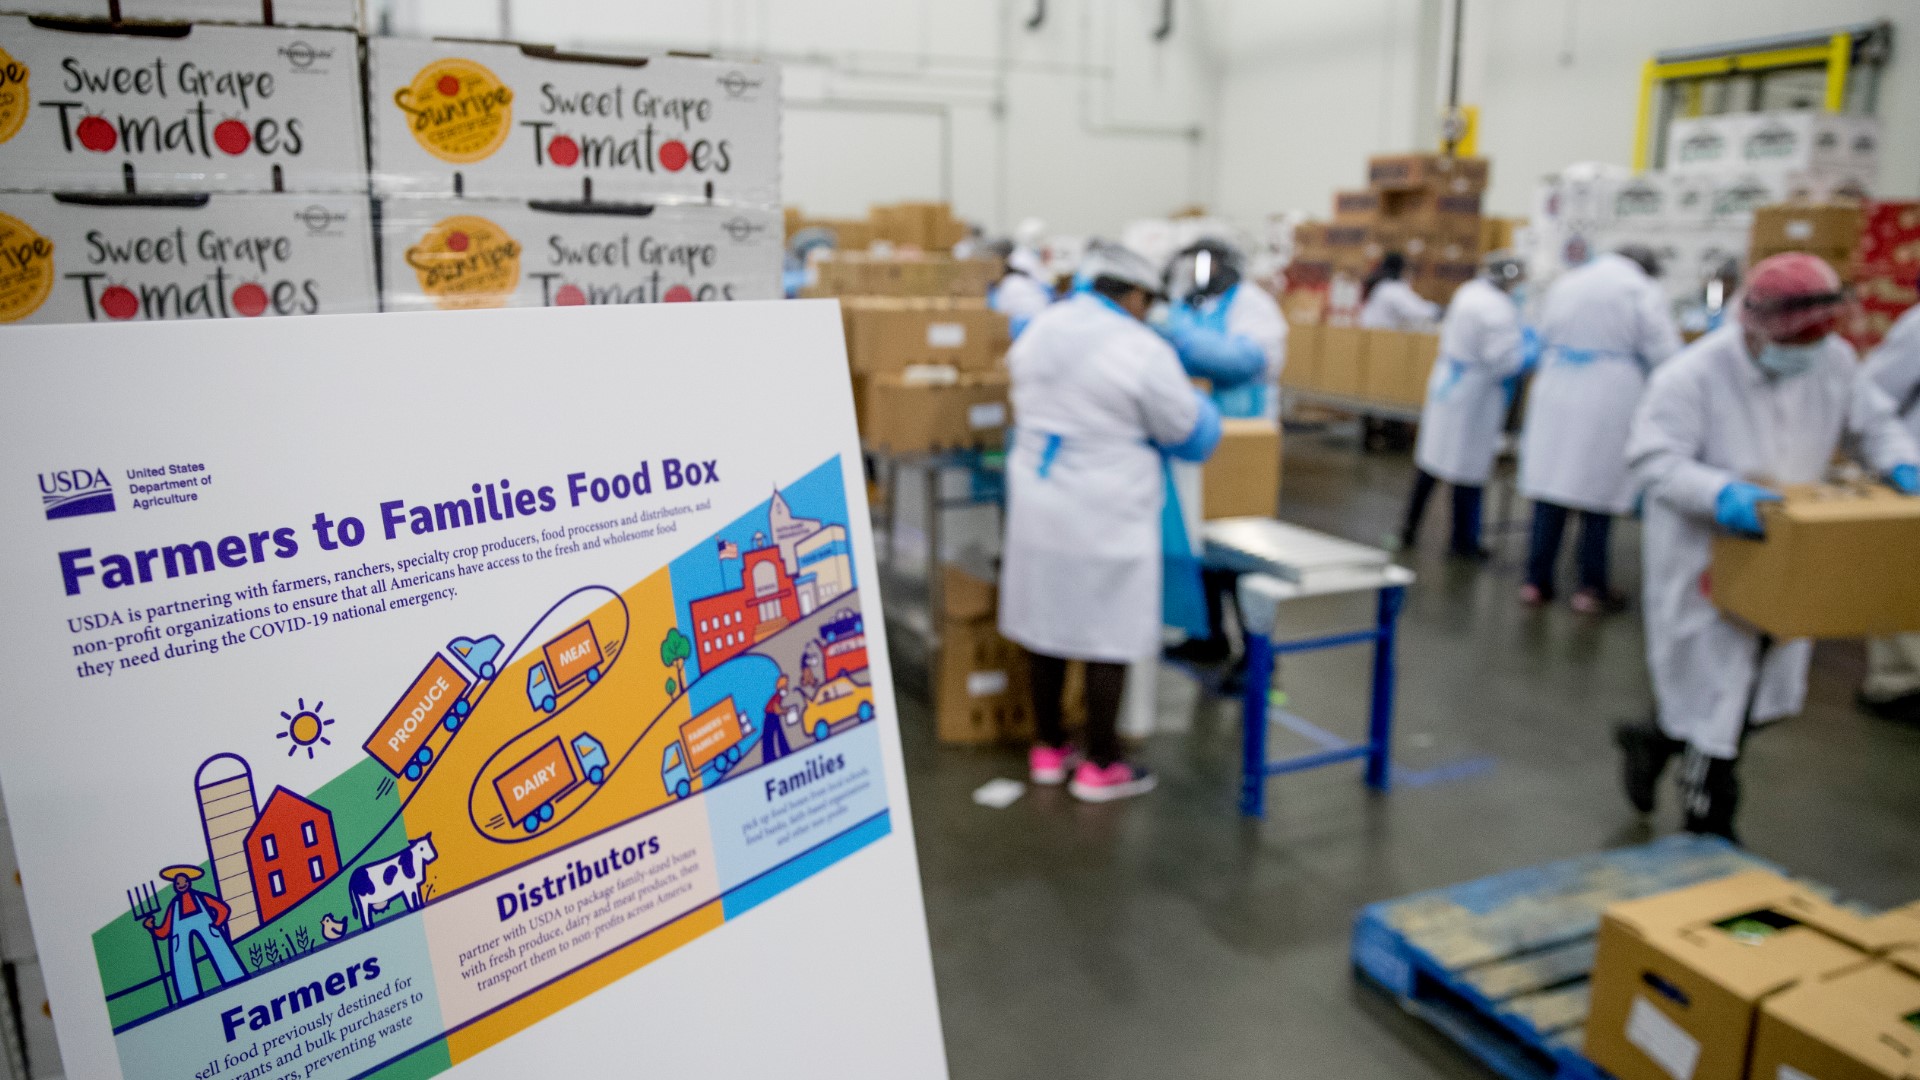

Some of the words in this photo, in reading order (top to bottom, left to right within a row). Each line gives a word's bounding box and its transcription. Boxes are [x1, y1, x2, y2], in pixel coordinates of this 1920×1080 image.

[61, 57, 167, 98] Sweet
[178, 62, 275, 110] Grape
[540, 82, 624, 119] Sweet
[634, 88, 711, 130] Grape
[39, 100, 303, 159] Tomatoes
[519, 121, 731, 175] Tomatoes
[85, 227, 188, 266] Sweet
[198, 231, 291, 273] Grape
[548, 235, 629, 268] Sweet
[639, 238, 716, 276] Grape
[64, 267, 320, 320] Tomatoes
[38, 467, 112, 495] USDA
[126, 466, 165, 480] United
[168, 462, 205, 476] States
[129, 476, 197, 495] Department
[200, 474, 212, 486] of
[58, 525, 299, 596] Farmers
[312, 512, 365, 551] to
[380, 478, 557, 541] Families
[567, 460, 652, 507] Food
[661, 458, 719, 490] Box
[132, 491, 198, 510] Agriculture
[67, 611, 124, 633] USDA
[128, 608, 142, 622] is
[146, 593, 232, 623] partnering
[234, 583, 268, 601] with
[272, 574, 331, 594] farmers,
[334, 563, 394, 582] ranchers,
[397, 550, 450, 572] specialty
[453, 544, 478, 560] crop
[481, 537, 539, 557] producers,
[542, 526, 565, 542] food
[568, 517, 619, 539] processors
[621, 511, 638, 526] and
[640, 505, 693, 522] distributors,
[696, 498, 711, 511] and
[72, 625, 162, 656] non-profit
[166, 604, 271, 637] organizations
[274, 602, 288, 615] to
[292, 592, 338, 611] ensure
[341, 585, 368, 601] that
[370, 578, 387, 594] all
[390, 569, 456, 591] Americans
[457, 564, 484, 577] have
[487, 553, 520, 570] access
[523, 551, 533, 563] to
[536, 548, 552, 560] the
[555, 541, 580, 557] fresh
[583, 536, 600, 551] and
[603, 526, 654, 547] wholesome
[656, 521, 677, 536] food
[76, 659, 115, 678] they
[119, 647, 160, 669] need
[164, 638, 219, 660] during
[221, 631, 246, 647] the
[249, 611, 329, 640] COVID-19
[332, 598, 386, 622] national
[389, 587, 458, 610] emergency.
[559, 639, 592, 667] MEAT
[387, 676, 451, 753] PRODUCE
[512, 762, 558, 801] DAIRY
[765, 753, 845, 802] Families
[496, 835, 661, 922] Distributors
[459, 938, 500, 967] partner
[503, 923, 527, 943] with
[529, 908, 562, 931] USDA
[564, 904, 575, 916] to
[577, 885, 615, 912] package
[461, 961, 487, 980] with
[489, 946, 516, 968] fresh
[518, 928, 564, 957] produce,
[566, 912, 591, 932] dairy
[593, 900, 611, 919] and
[613, 892, 635, 909] meat
[477, 960, 528, 991] transport
[530, 947, 557, 967] them
[559, 941, 570, 952] to
[220, 957, 381, 1043] Farmers
[195, 1060, 221, 1080] sell
[224, 1043, 259, 1070] food
[262, 1012, 333, 1057] previously
[337, 983, 392, 1018] destined
[394, 976, 412, 992] for
[276, 1044, 303, 1067] and
[305, 1030, 338, 1053] bulk
[340, 998, 408, 1042] purchasers
[410, 992, 423, 1004] to
[304, 1033, 377, 1078] preventing
[378, 1016, 413, 1039] waste
